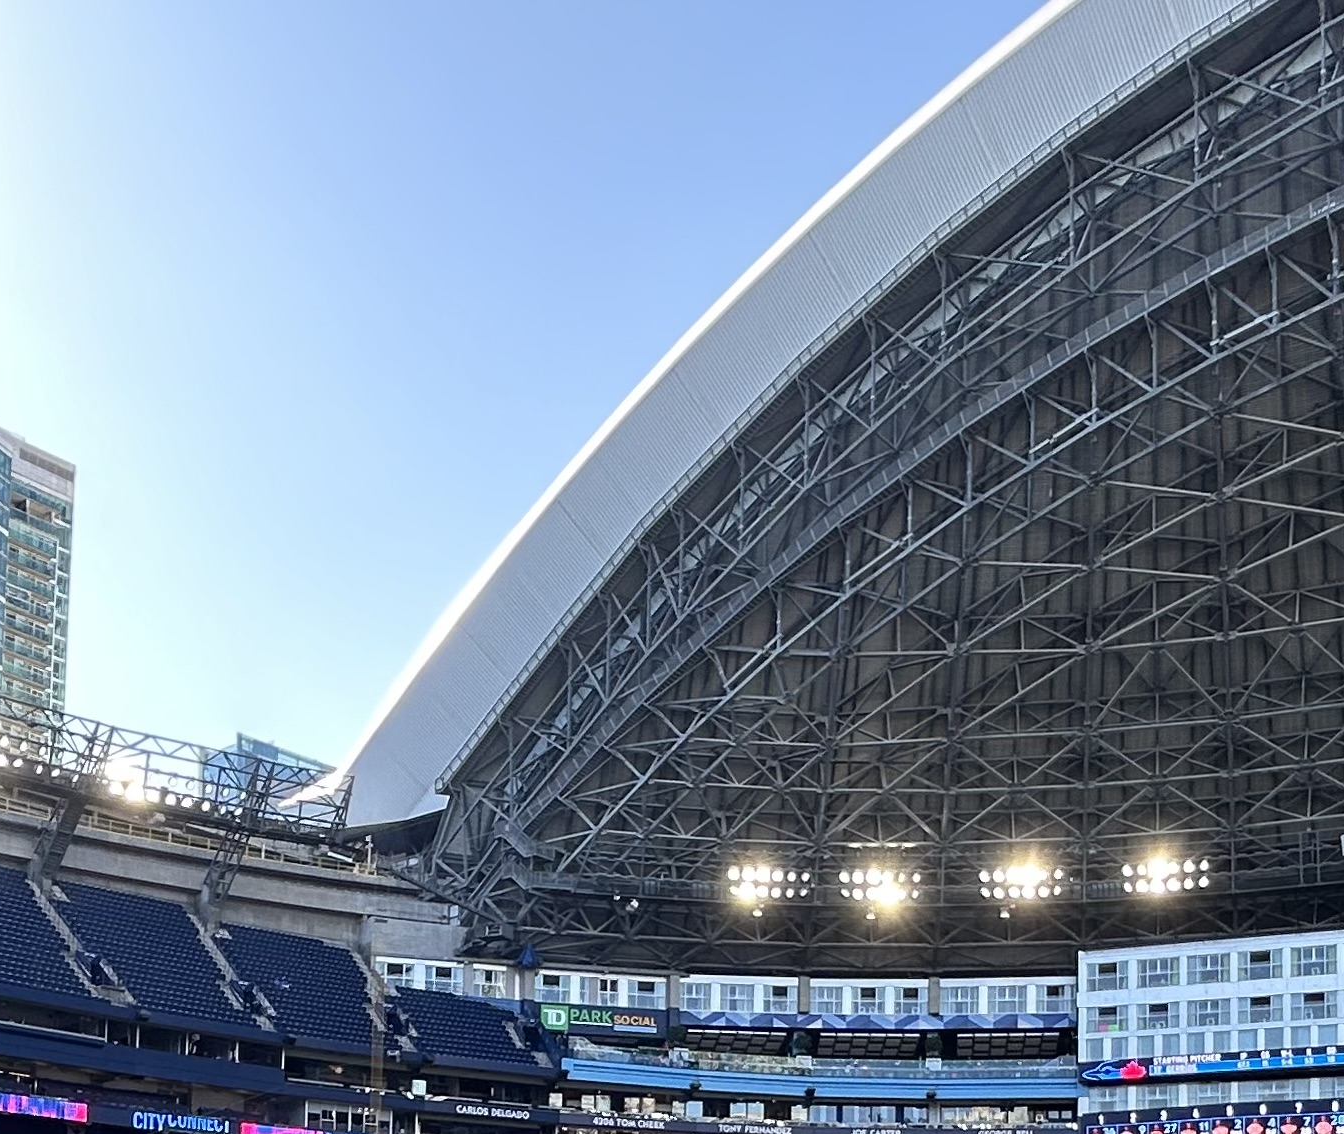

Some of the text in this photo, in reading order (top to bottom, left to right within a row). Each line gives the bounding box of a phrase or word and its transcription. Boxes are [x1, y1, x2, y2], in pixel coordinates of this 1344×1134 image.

[543, 1009, 657, 1027] TD PARK SOCIAL
[1190, 1053, 1222, 1062] PITCHER
[456, 1105, 530, 1120] CARLOS DELGADO
[132, 1111, 166, 1132] CITY
[615, 1118, 633, 1129] TOM
[1234, 1118, 1243, 1129] 2
[1267, 1118, 1276, 1128] 4
[1303, 1116, 1311, 1128] 7
[718, 1124, 741, 1134] TONY
[1164, 1123, 1178, 1134] 27
